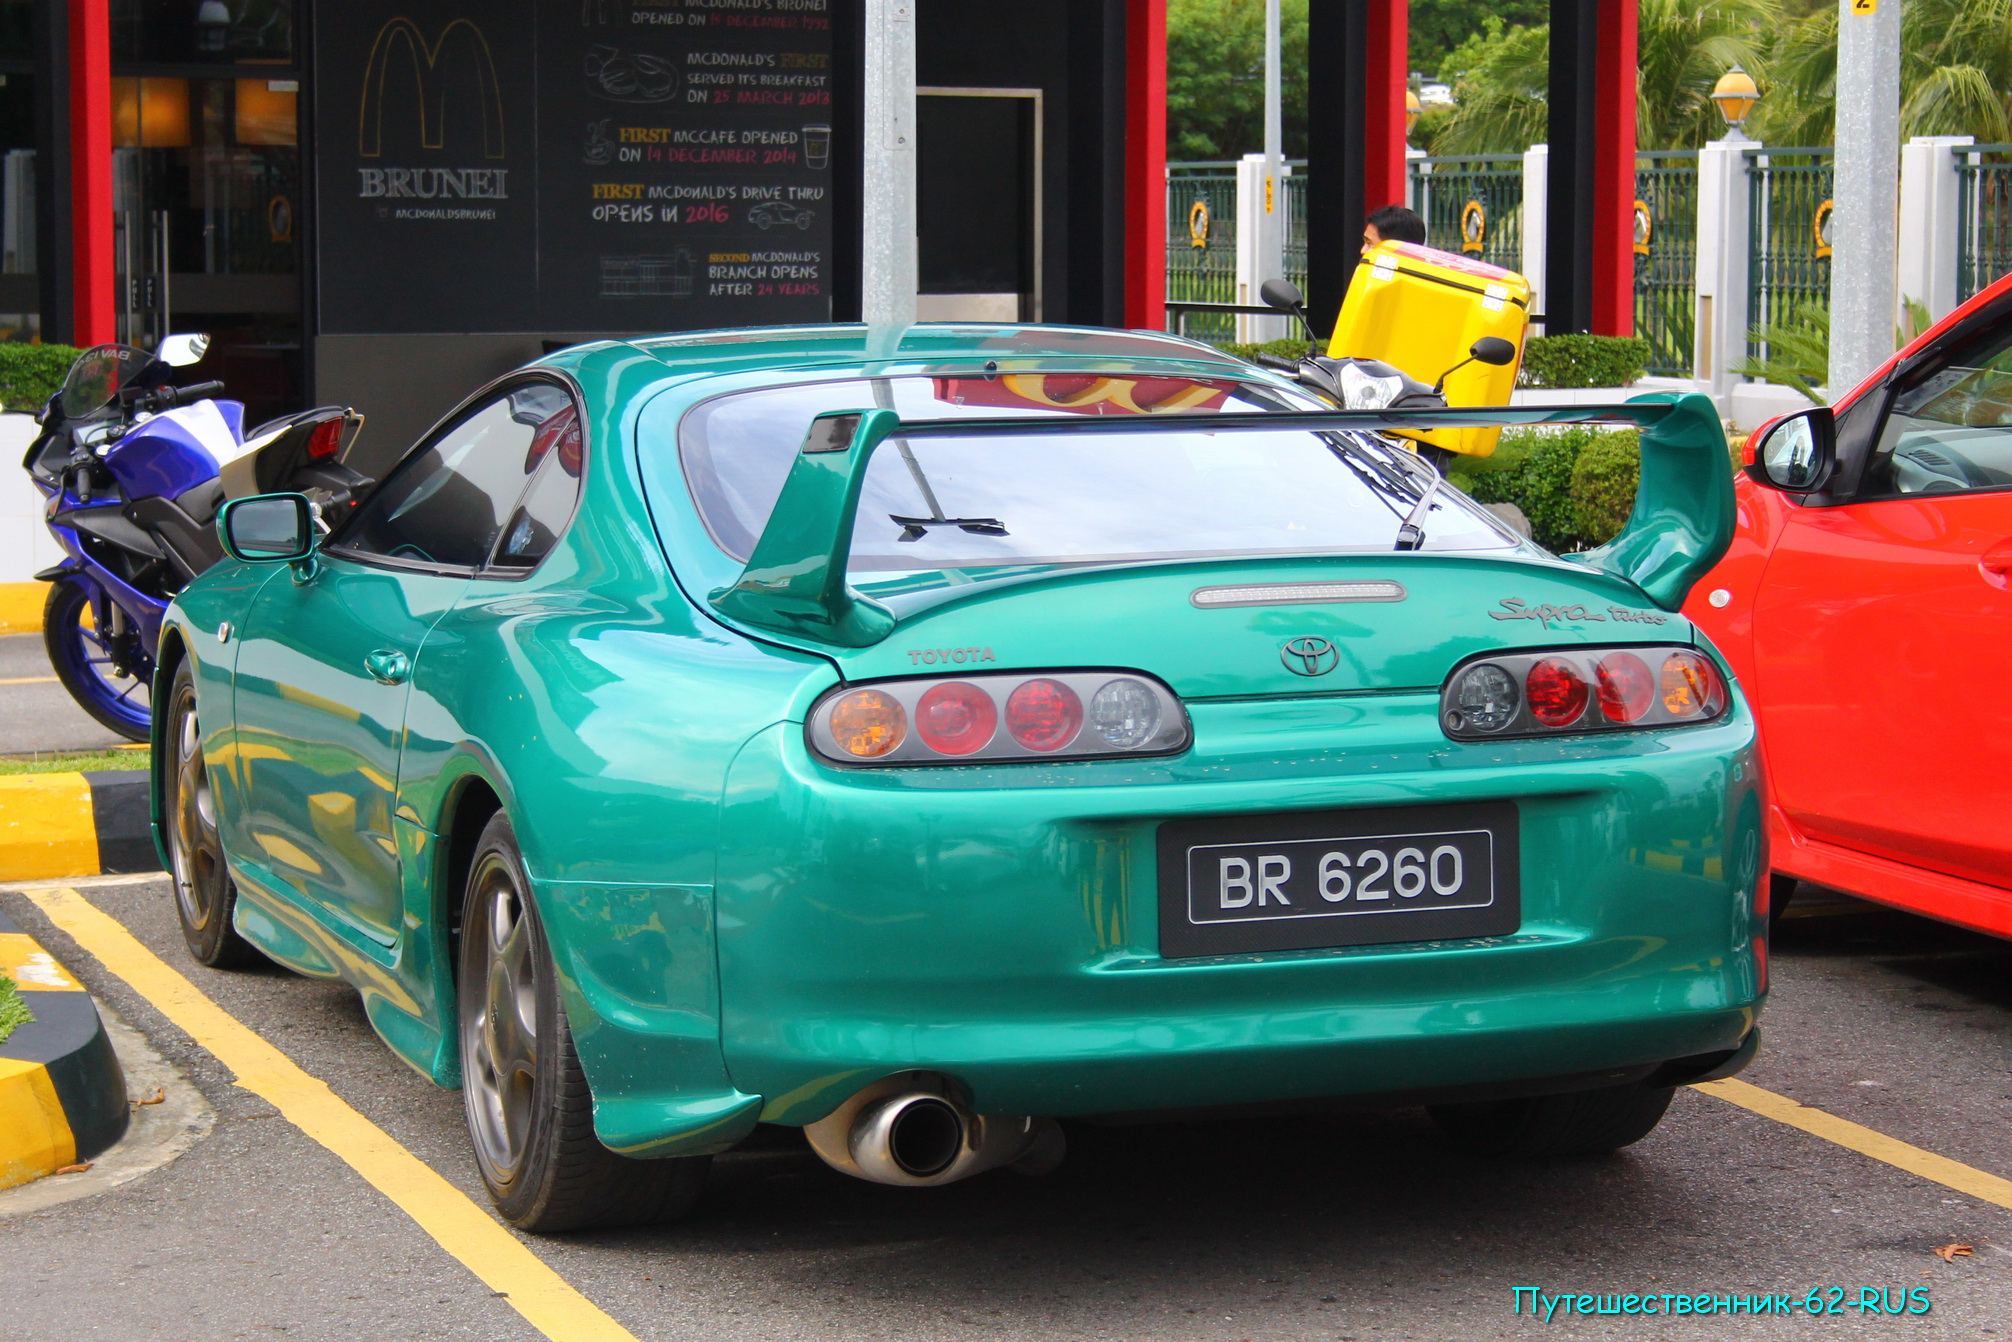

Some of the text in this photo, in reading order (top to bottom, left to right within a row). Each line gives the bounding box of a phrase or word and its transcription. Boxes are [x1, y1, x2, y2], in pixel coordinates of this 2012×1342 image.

[631, 12, 684, 25] OPENED
[688, 13, 706, 26] ON
[687, 52, 829, 68] MCDONALD'S FIRST
[687, 73, 826, 87] SERVED ITS BREAKFAST
[687, 90, 708, 103] ON
[737, 91, 793, 104] MARCH
[619, 127, 798, 144] FIRST MCCAFE OPENED
[619, 146, 797, 164] ON 14 DECEMBER 2014
[358, 168, 508, 199] BRUNEI
[592, 184, 645, 199] FIRST
[648, 186, 737, 200] MCDONALD'S
[788, 187, 824, 200] THRU
[592, 204, 653, 222] OPENS
[686, 202, 729, 223] 2016
[709, 252, 821, 263] SECOND MCDONALD'S
[709, 265, 819, 279] BRANCH OPENS
[709, 283, 821, 296] AFTER 24 YEARS
[1487, 597, 1667, 630] Supra turbo
[907, 647, 996, 665] TOYOTA
[1220, 845, 1463, 909] BR 6260
